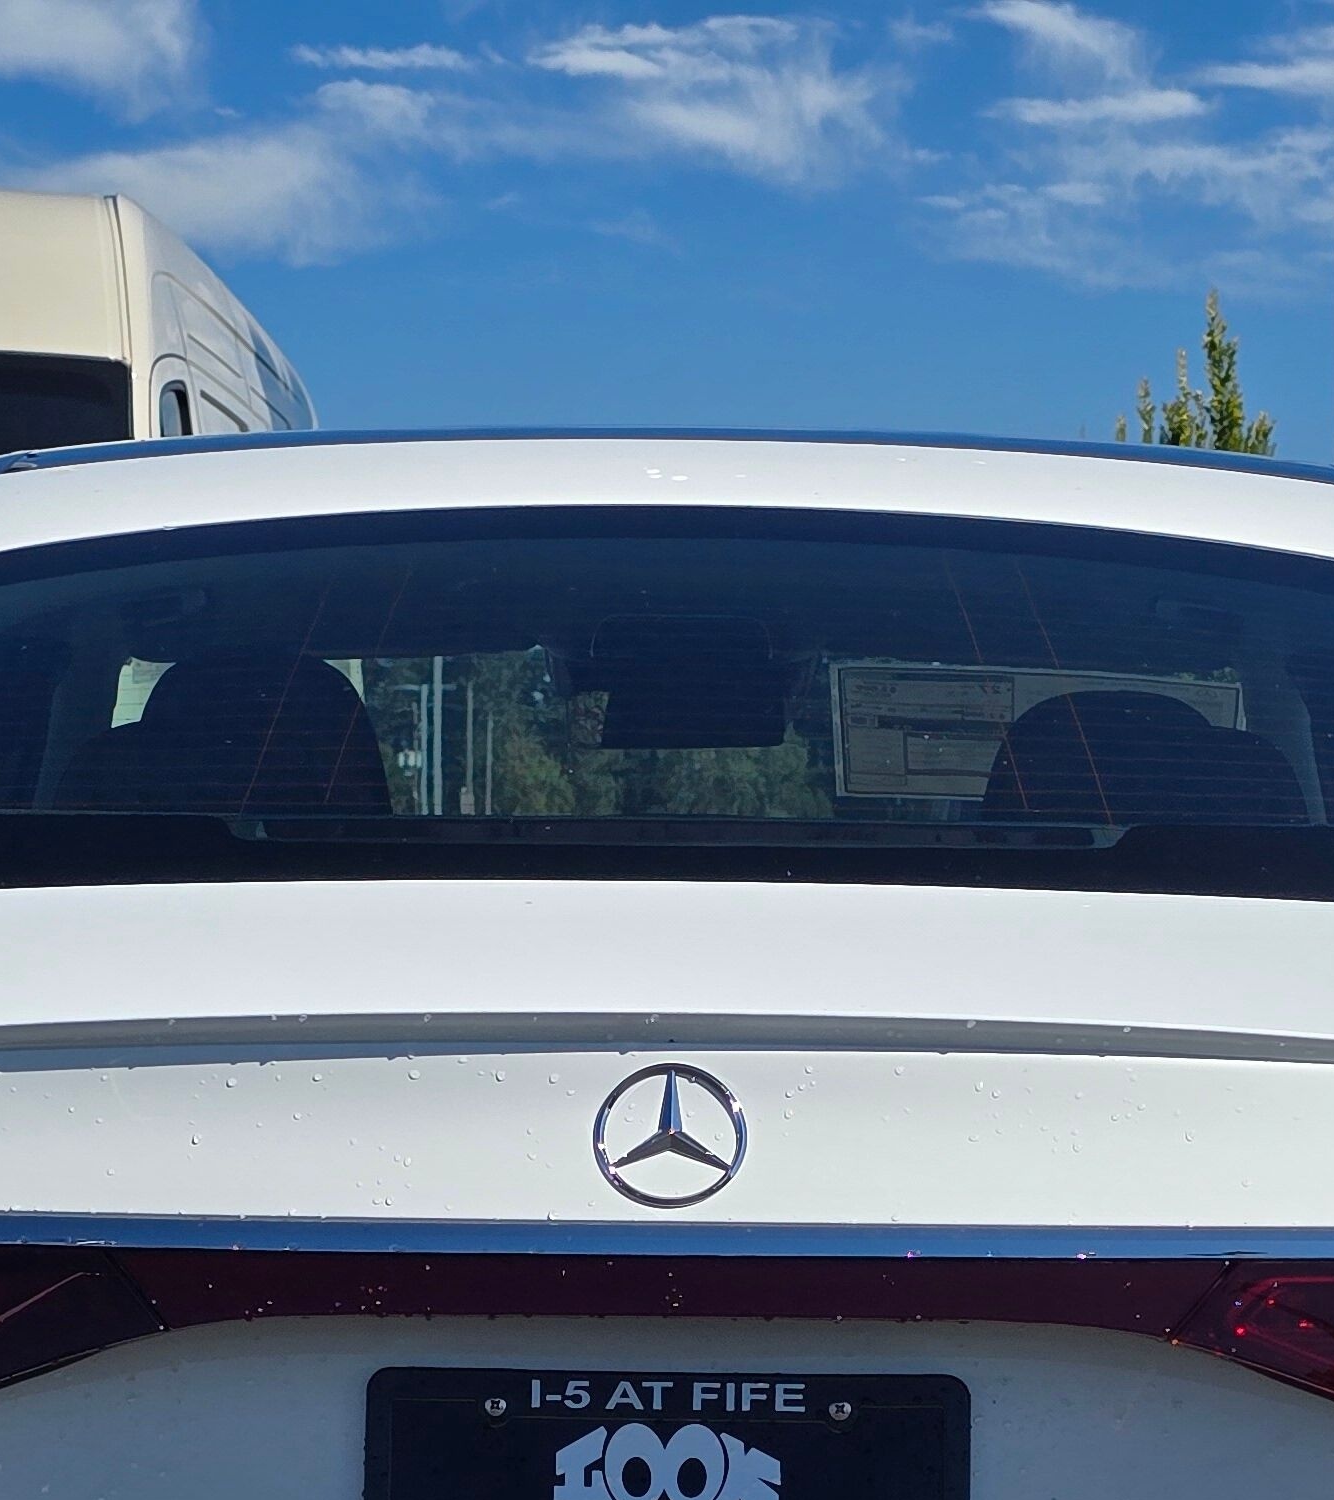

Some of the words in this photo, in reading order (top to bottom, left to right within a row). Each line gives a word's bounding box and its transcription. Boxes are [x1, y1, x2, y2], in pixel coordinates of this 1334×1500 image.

[530, 1379, 592, 1409] I-5
[605, 1380, 674, 1411] AT
[691, 1381, 806, 1413] FIFE
